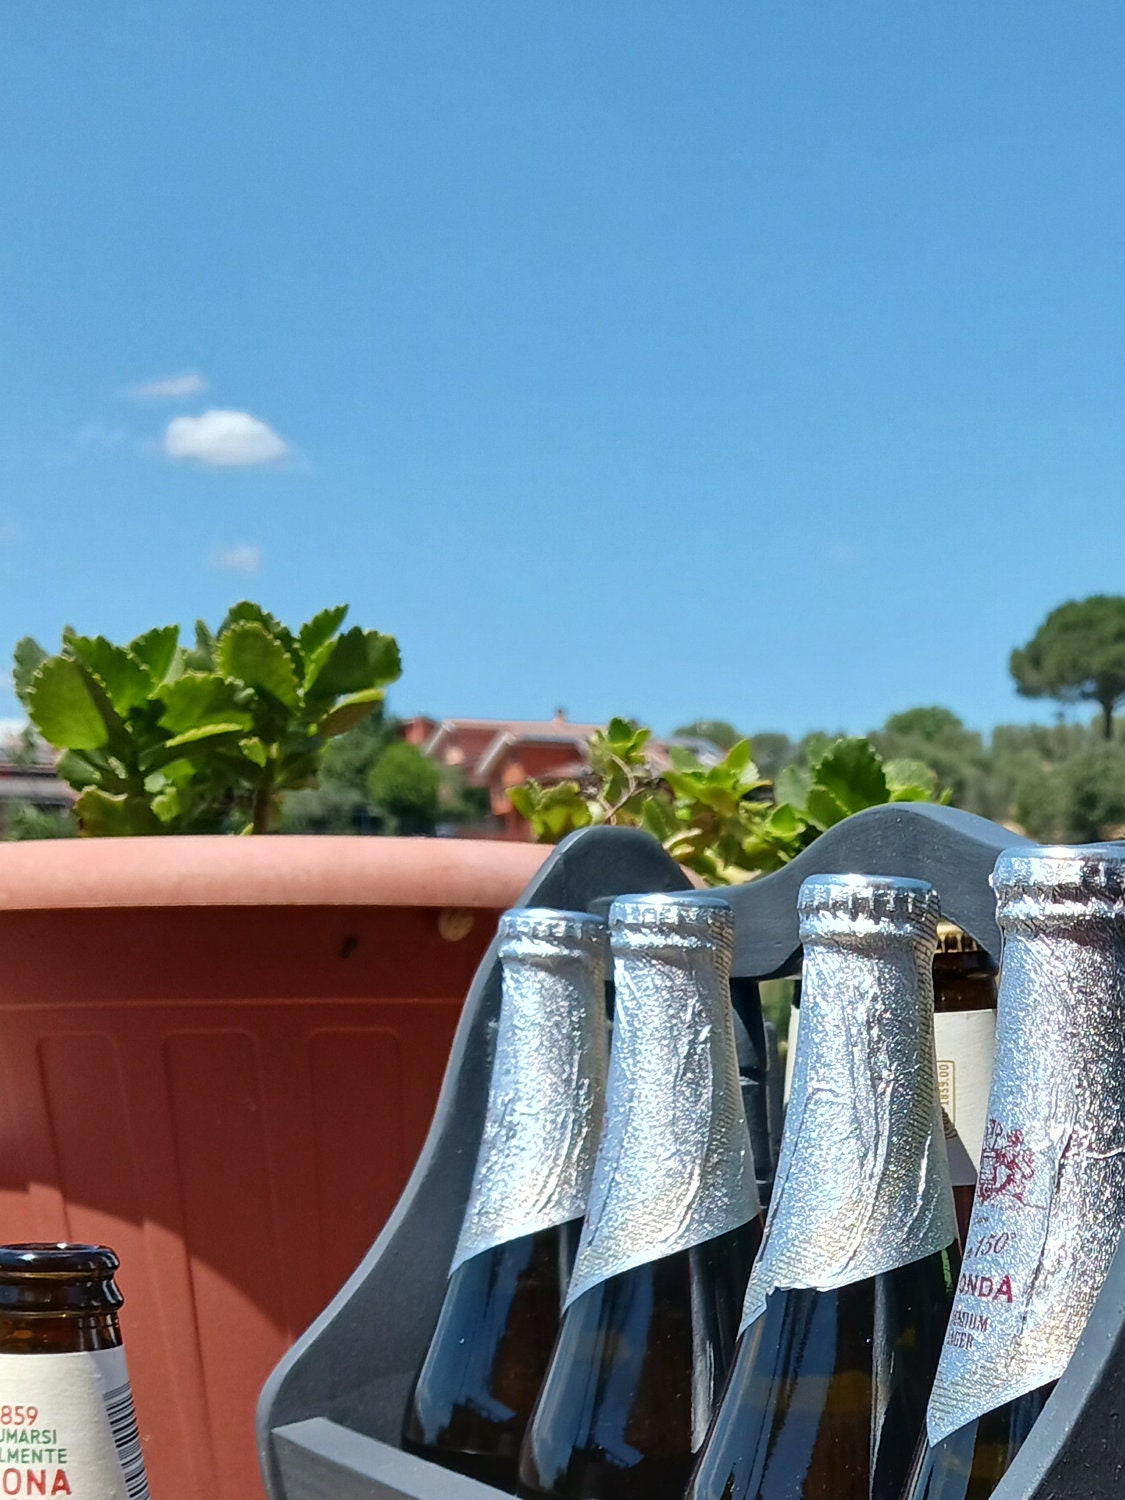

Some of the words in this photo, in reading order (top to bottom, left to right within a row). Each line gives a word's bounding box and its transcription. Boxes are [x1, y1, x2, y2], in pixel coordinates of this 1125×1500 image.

[958, 1272, 1014, 1304] ONDA
[0, 1405, 39, 1426] 859
[2, 1467, 72, 1496] ONA
